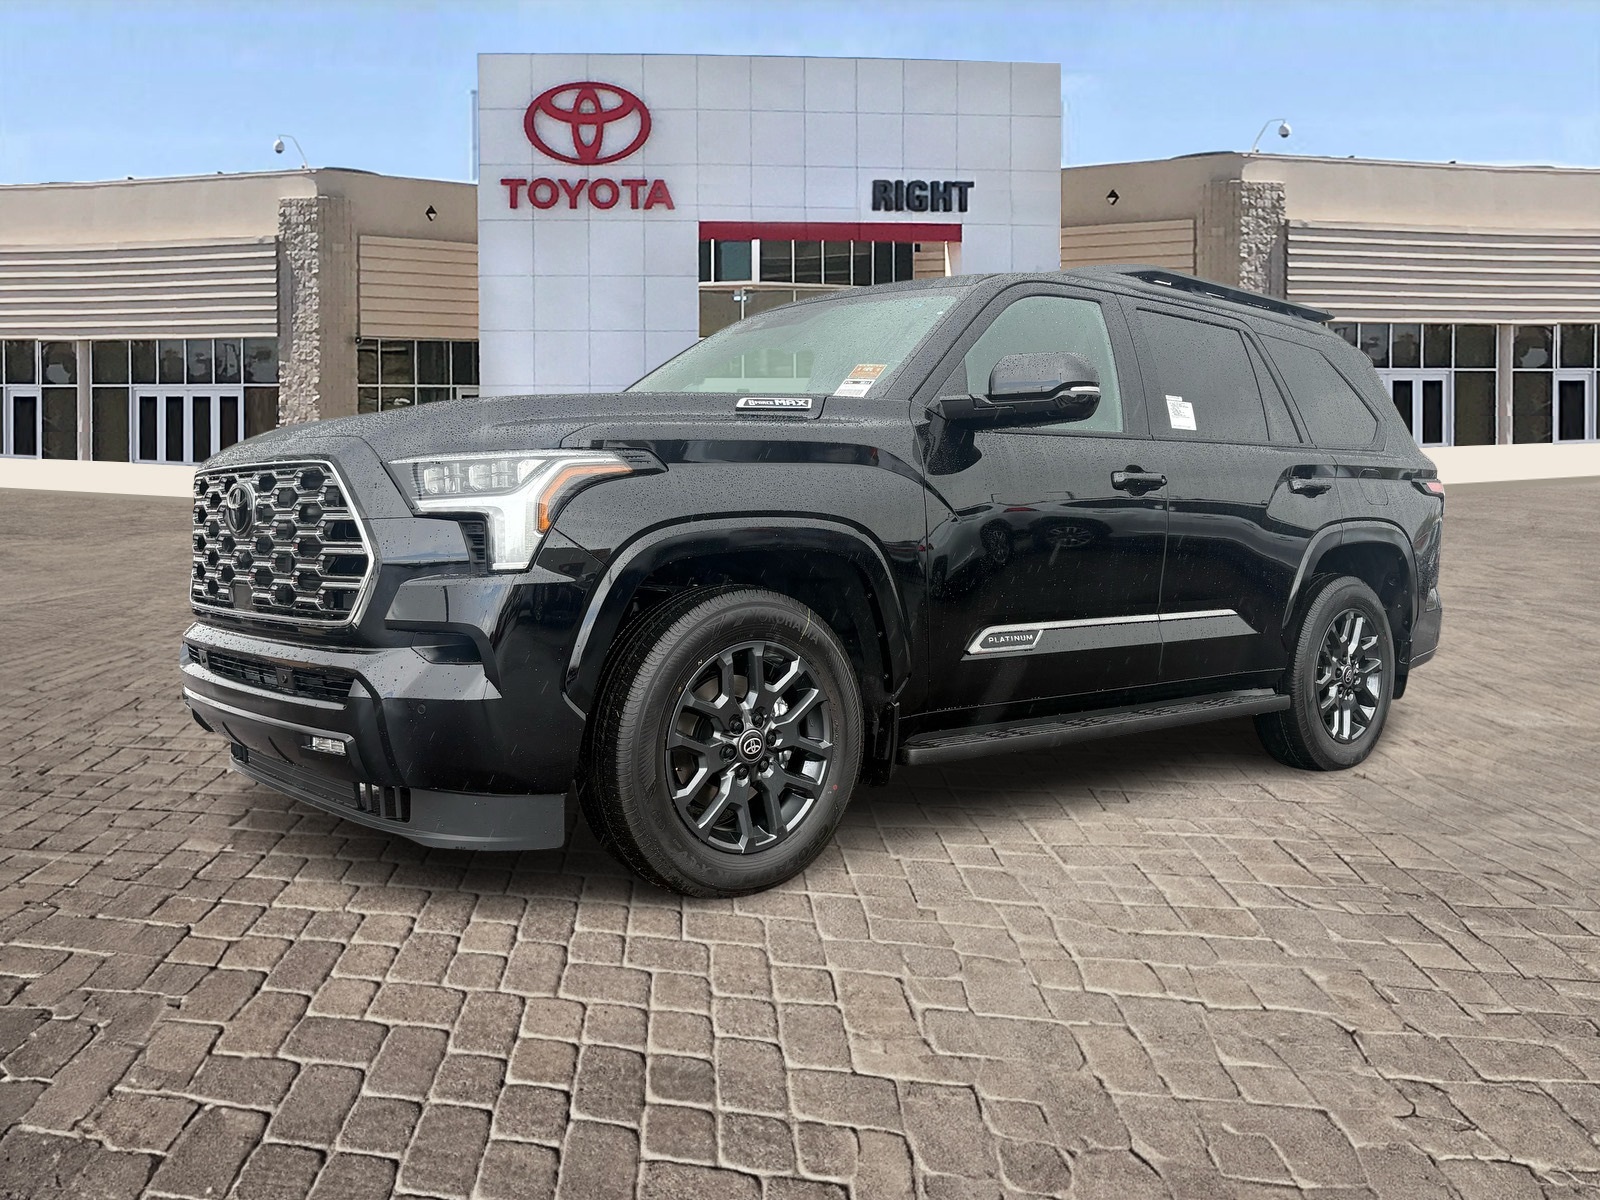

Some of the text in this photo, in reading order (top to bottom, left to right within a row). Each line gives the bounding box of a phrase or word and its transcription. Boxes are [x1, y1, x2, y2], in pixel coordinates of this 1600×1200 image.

[500, 177, 675, 210] TOYOTA
[872, 179, 975, 212] RIGHT
[774, 399, 807, 407] MAX
[988, 634, 1033, 643] PLATINUM
